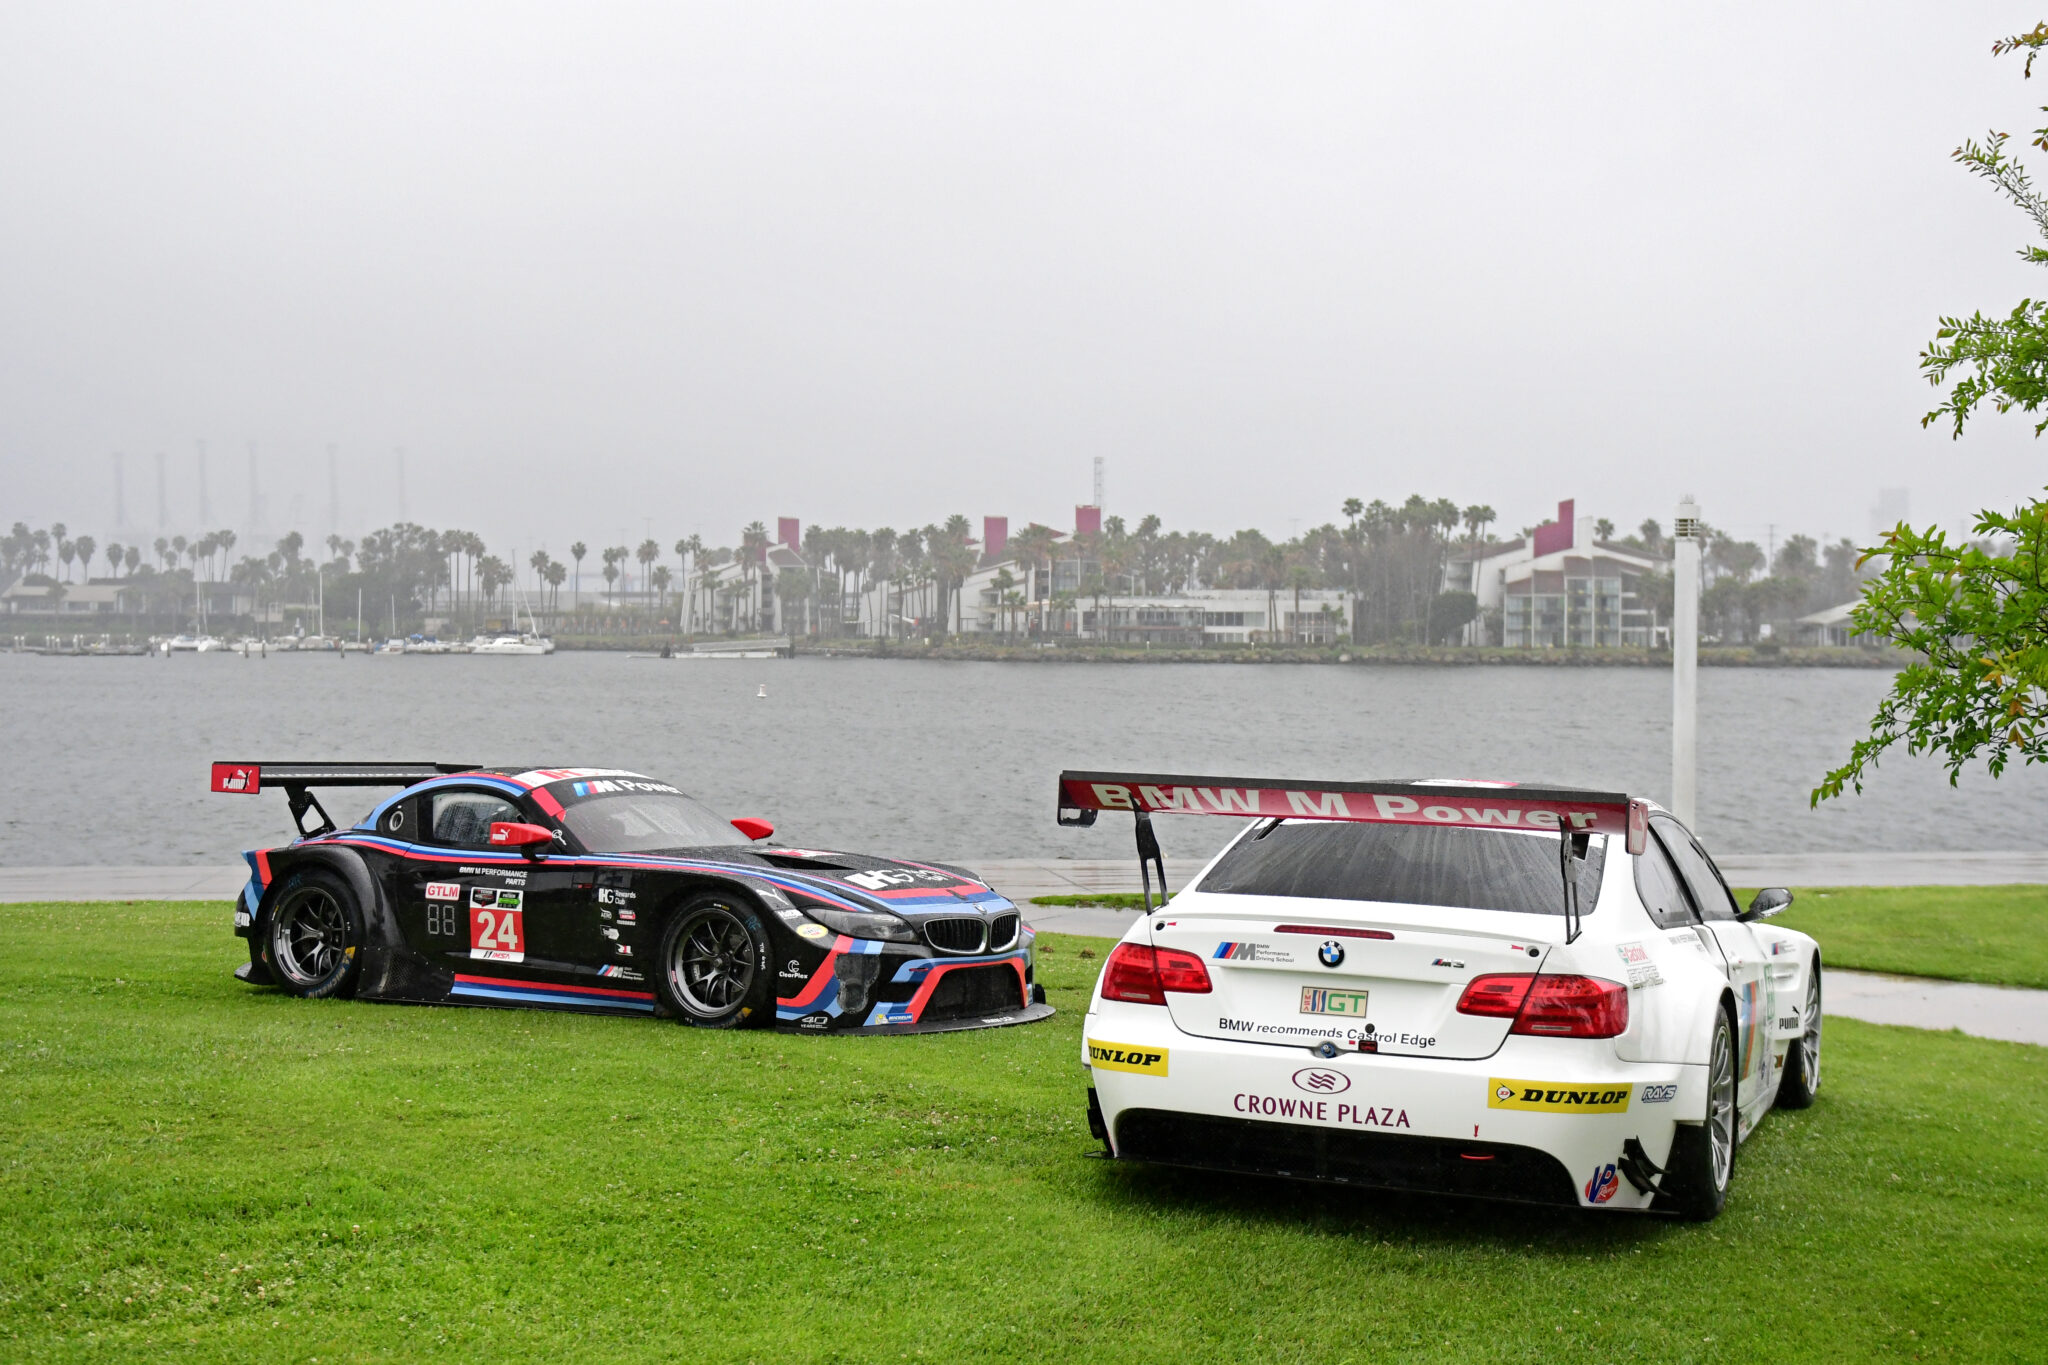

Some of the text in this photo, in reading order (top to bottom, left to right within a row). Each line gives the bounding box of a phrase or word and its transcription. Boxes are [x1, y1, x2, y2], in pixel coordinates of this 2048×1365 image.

[1090, 783, 1598, 828] BMW M Power
[481, 867, 528, 878] PERFORMANCE
[505, 878, 526, 886] PARTS
[427, 885, 459, 898] GTLM
[477, 911, 518, 950] 24
[1327, 993, 1366, 1013] GT
[1778, 1017, 1799, 1030] PUMA
[1219, 1018, 1436, 1048] BMW recommends Castrol Edge
[1520, 1088, 1628, 1105] DUNLOP
[1642, 1085, 1677, 1101] RAYS
[1233, 1093, 1411, 1128] CROWNE PLAZA
